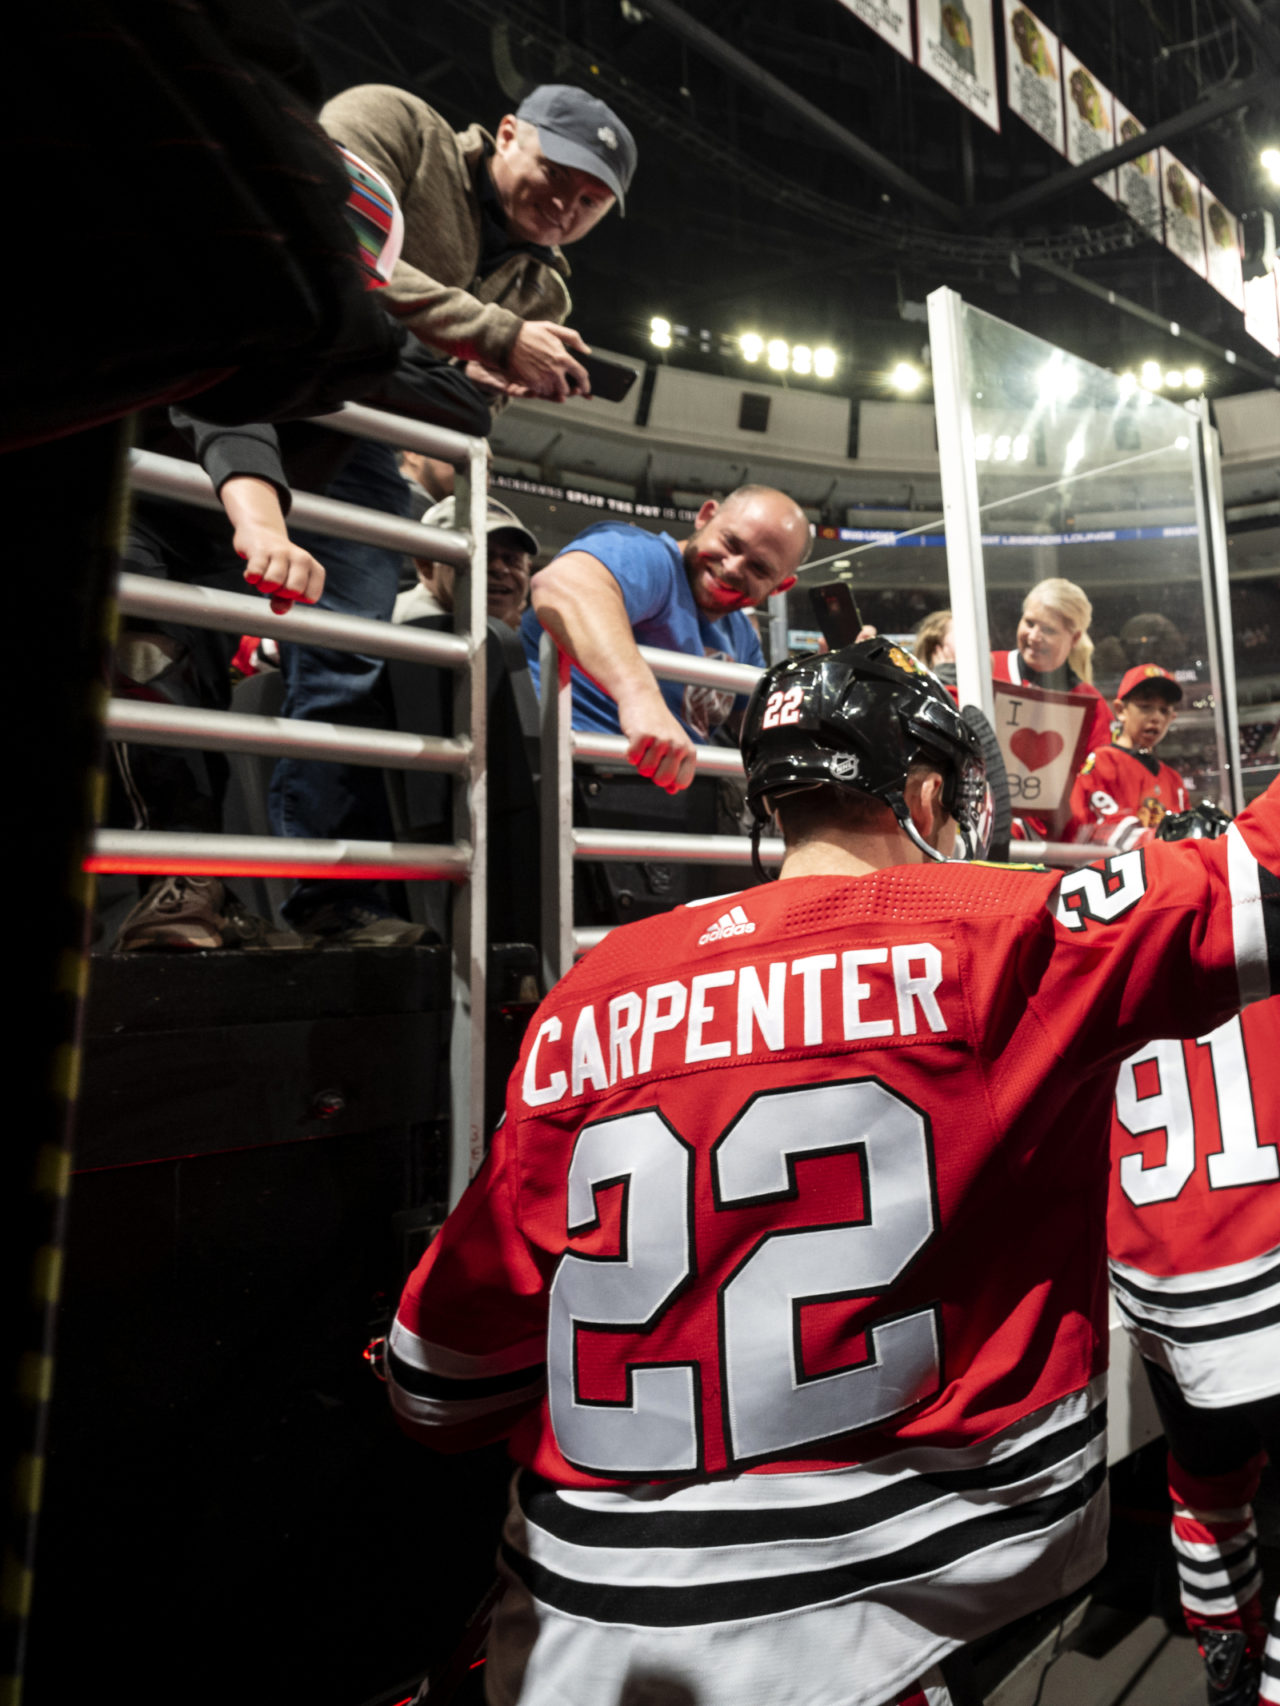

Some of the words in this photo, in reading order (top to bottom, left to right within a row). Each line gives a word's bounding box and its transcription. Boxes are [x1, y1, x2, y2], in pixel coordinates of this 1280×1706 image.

[566, 489, 604, 508] SPLIT
[762, 685, 804, 731] 22
[1005, 699, 1023, 727] I
[697, 921, 757, 946] adidas
[521, 941, 949, 1109] CARPENTER
[546, 1074, 945, 1482] 22
